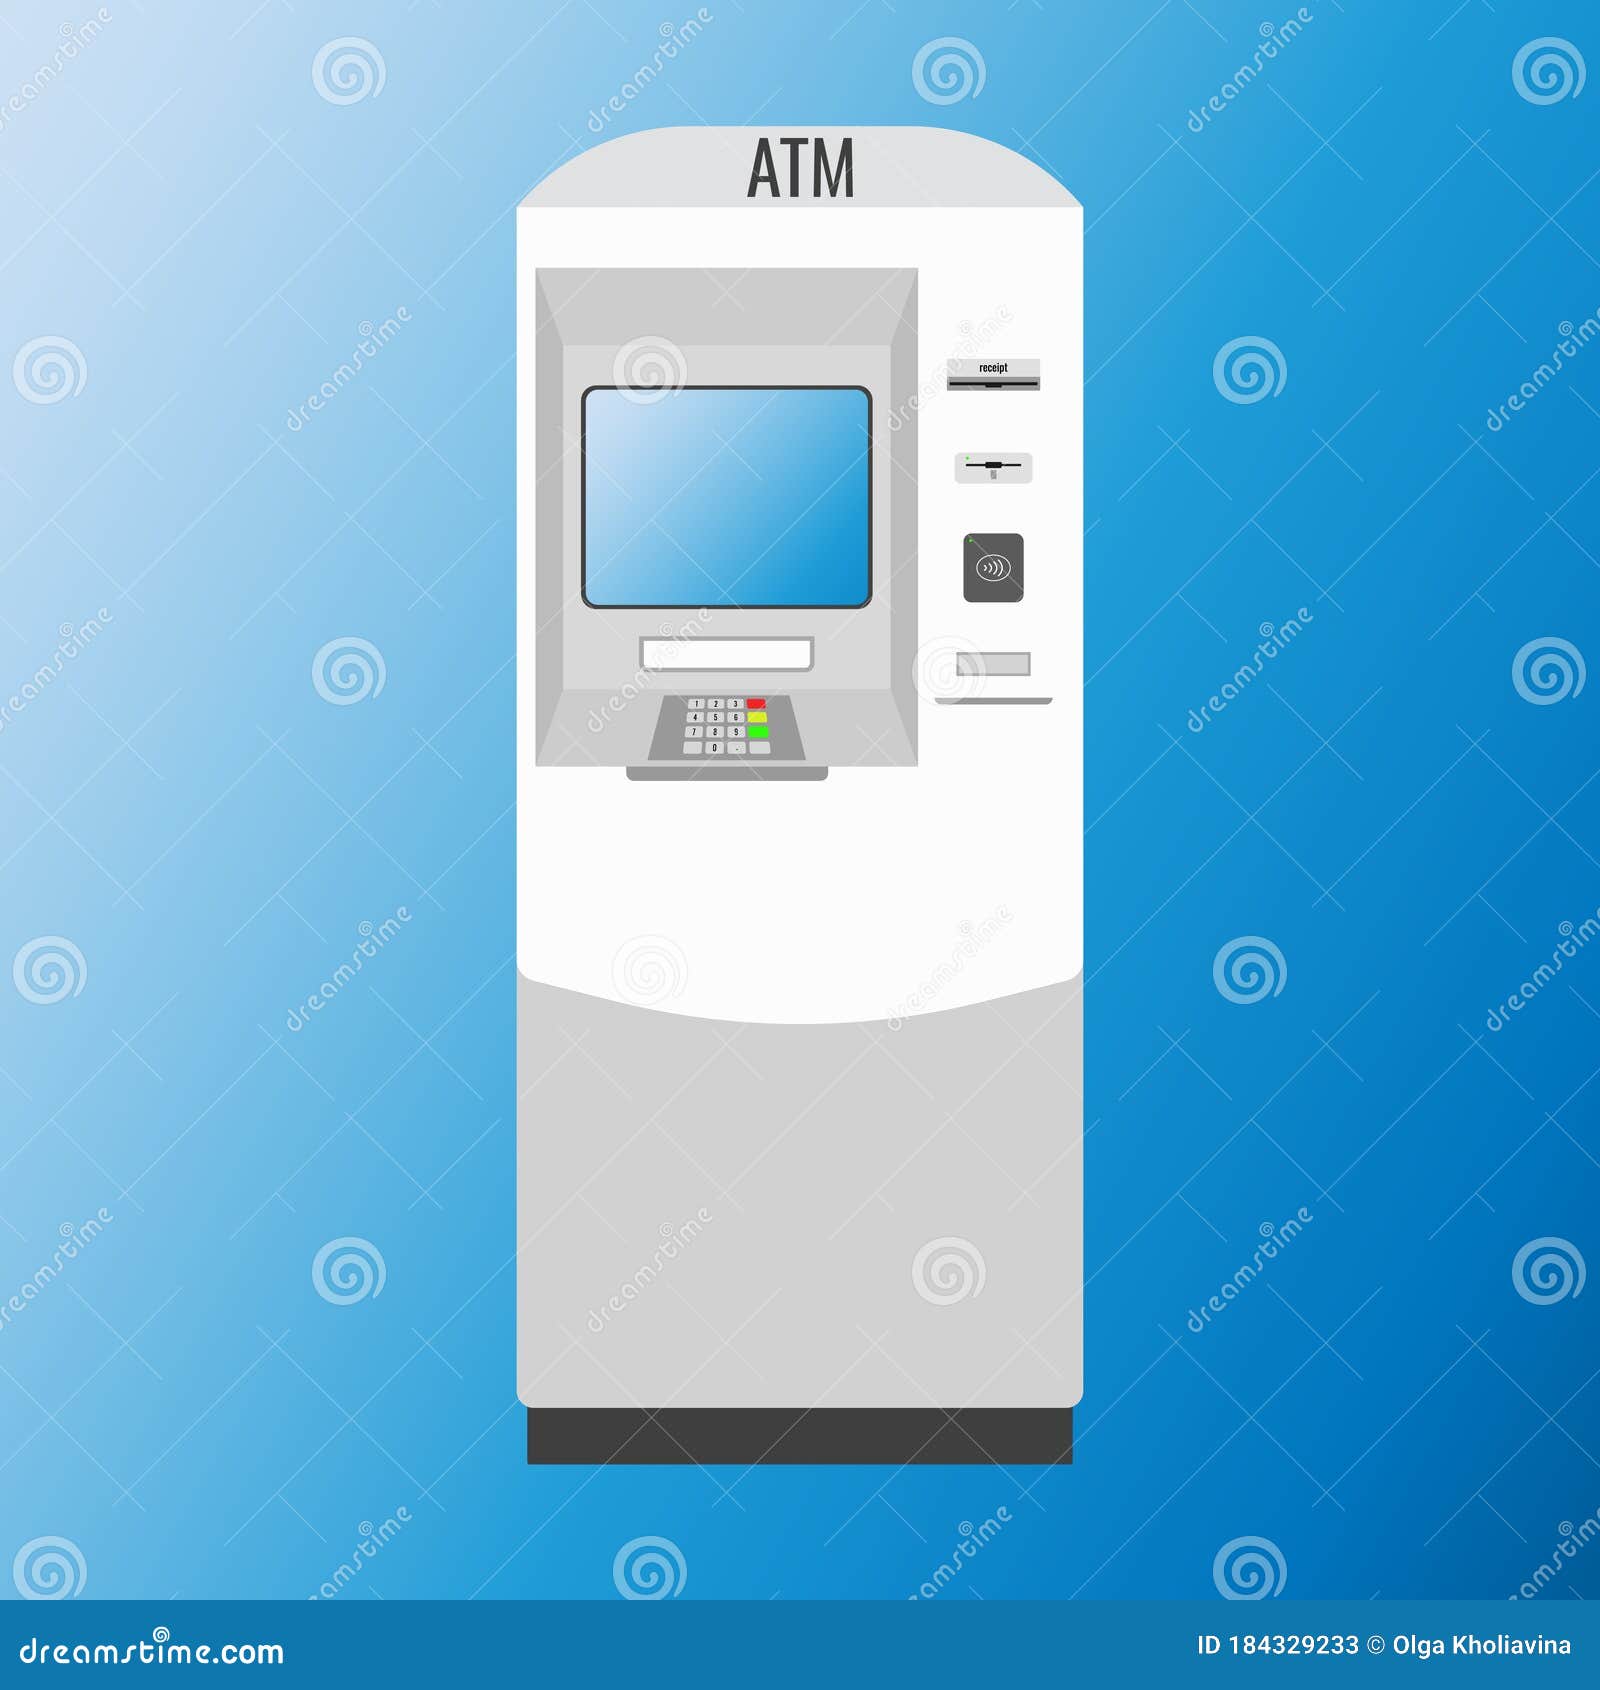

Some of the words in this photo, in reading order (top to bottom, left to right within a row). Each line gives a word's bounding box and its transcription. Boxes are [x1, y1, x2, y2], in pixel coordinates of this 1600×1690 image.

[747, 137, 854, 198] ATM
[979, 363, 1009, 374] receipt
[714, 700, 719, 708] 2
[733, 700, 738, 708] 3
[693, 713, 698, 721] 4
[713, 713, 718, 721] 5
[733, 713, 739, 721] 6
[692, 727, 697, 736] 7
[713, 727, 718, 736] 8
[734, 727, 739, 736] 9
[712, 743, 717, 752] 0
